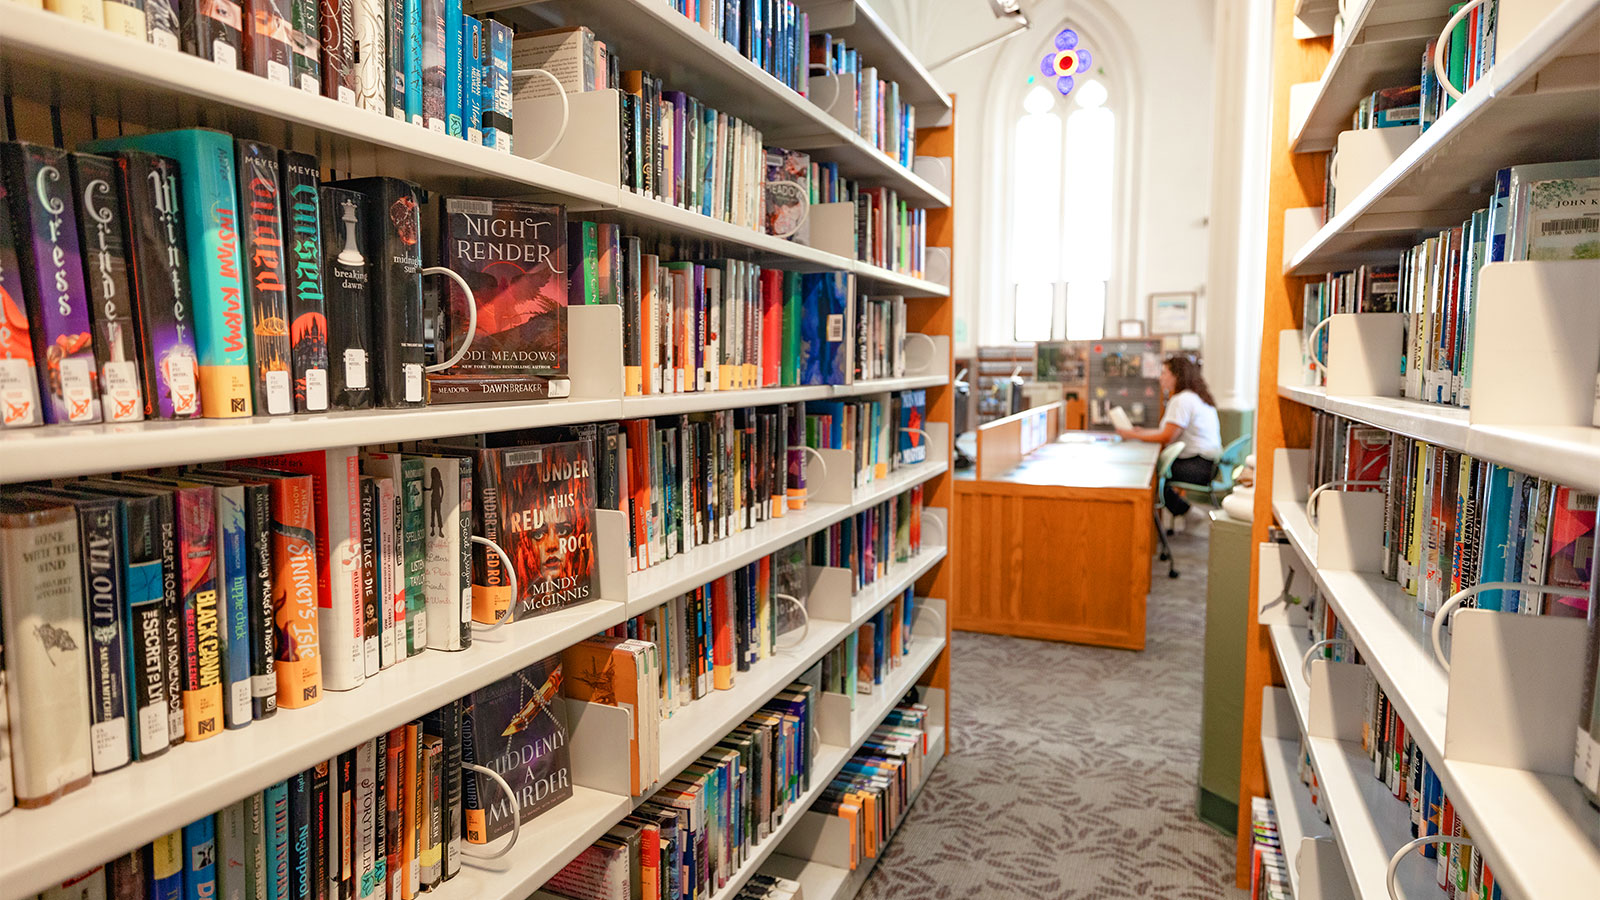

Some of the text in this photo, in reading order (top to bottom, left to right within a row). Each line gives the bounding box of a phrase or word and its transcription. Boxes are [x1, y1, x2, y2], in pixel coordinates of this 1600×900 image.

[244, 155, 279, 170] MEYER
[288, 164, 320, 179] MEYER
[1555, 199, 1587, 208] JOHN
[36, 166, 72, 316] Cress
[461, 212, 551, 240] NIGHT
[84, 179, 118, 343] Cinder
[215, 207, 240, 284] INSTANT
[457, 239, 564, 274] RENDER
[334, 267, 368, 284] breaking
[342, 279, 364, 291] dawn
[221, 286, 245, 353] KARMA
[461, 350, 557, 362] ODI MEADOWS
[438, 381, 544, 397] MEADOWS DAWNBREAKER
[542, 459, 590, 483] UNDER
[362, 495, 373, 534] PERFECT
[483, 487, 498, 526] UNDER
[550, 493, 575, 509] THIS
[511, 508, 545, 534] RED
[1464, 499, 1475, 546] MONSTER
[364, 537, 373, 568] PLACE
[460, 517, 472, 588] Secret Assignm
[559, 532, 593, 555] ROCK
[89, 531, 115, 622] ALL OUT
[353, 571, 361, 616] elizabeth
[364, 578, 374, 597] DIE
[410, 573, 425, 587] TAYLO
[487, 569, 501, 585] RO
[532, 575, 579, 597] MINDY
[196, 589, 218, 640] BLACK
[232, 576, 246, 641] hippie chick
[523, 585, 590, 612] McGINNIS
[163, 523, 180, 713] DESERT ROSE KAT MOMENZAD
[142, 618, 161, 673] SECRET
[186, 608, 198, 690] BREAKING SILENCE
[293, 623, 319, 659] Isle
[198, 639, 220, 688] CANAR
[101, 684, 112, 721] MITCHE
[485, 730, 566, 781] SUDDENLY
[524, 765, 535, 783] A
[467, 777, 477, 809] MURD
[489, 767, 569, 826] MURDER
[275, 794, 287, 840] THE
[361, 778, 375, 874] STORYTELLER
[295, 824, 310, 898] Nightpool
